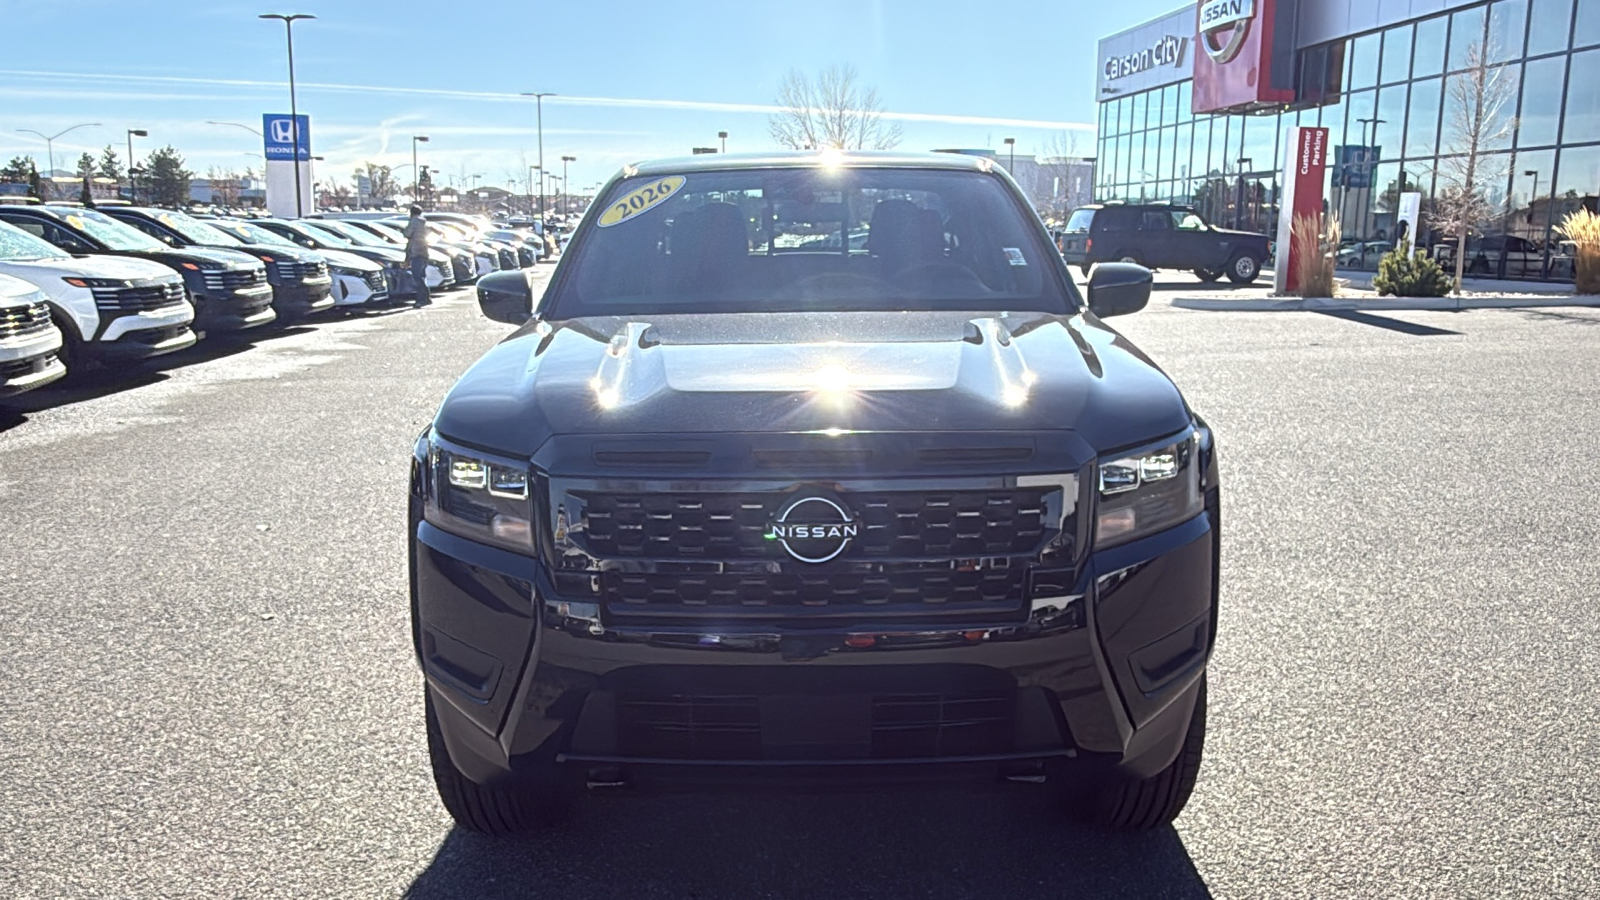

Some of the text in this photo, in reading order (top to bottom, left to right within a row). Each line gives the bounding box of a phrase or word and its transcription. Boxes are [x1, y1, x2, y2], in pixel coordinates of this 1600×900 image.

[1201, 0, 1241, 24] ISSAN
[1104, 36, 1184, 80] Carson City
[1301, 130, 1311, 175] Customer
[1312, 130, 1324, 165] Parking
[615, 182, 671, 218] 2026
[772, 525, 857, 538] NISSAN
